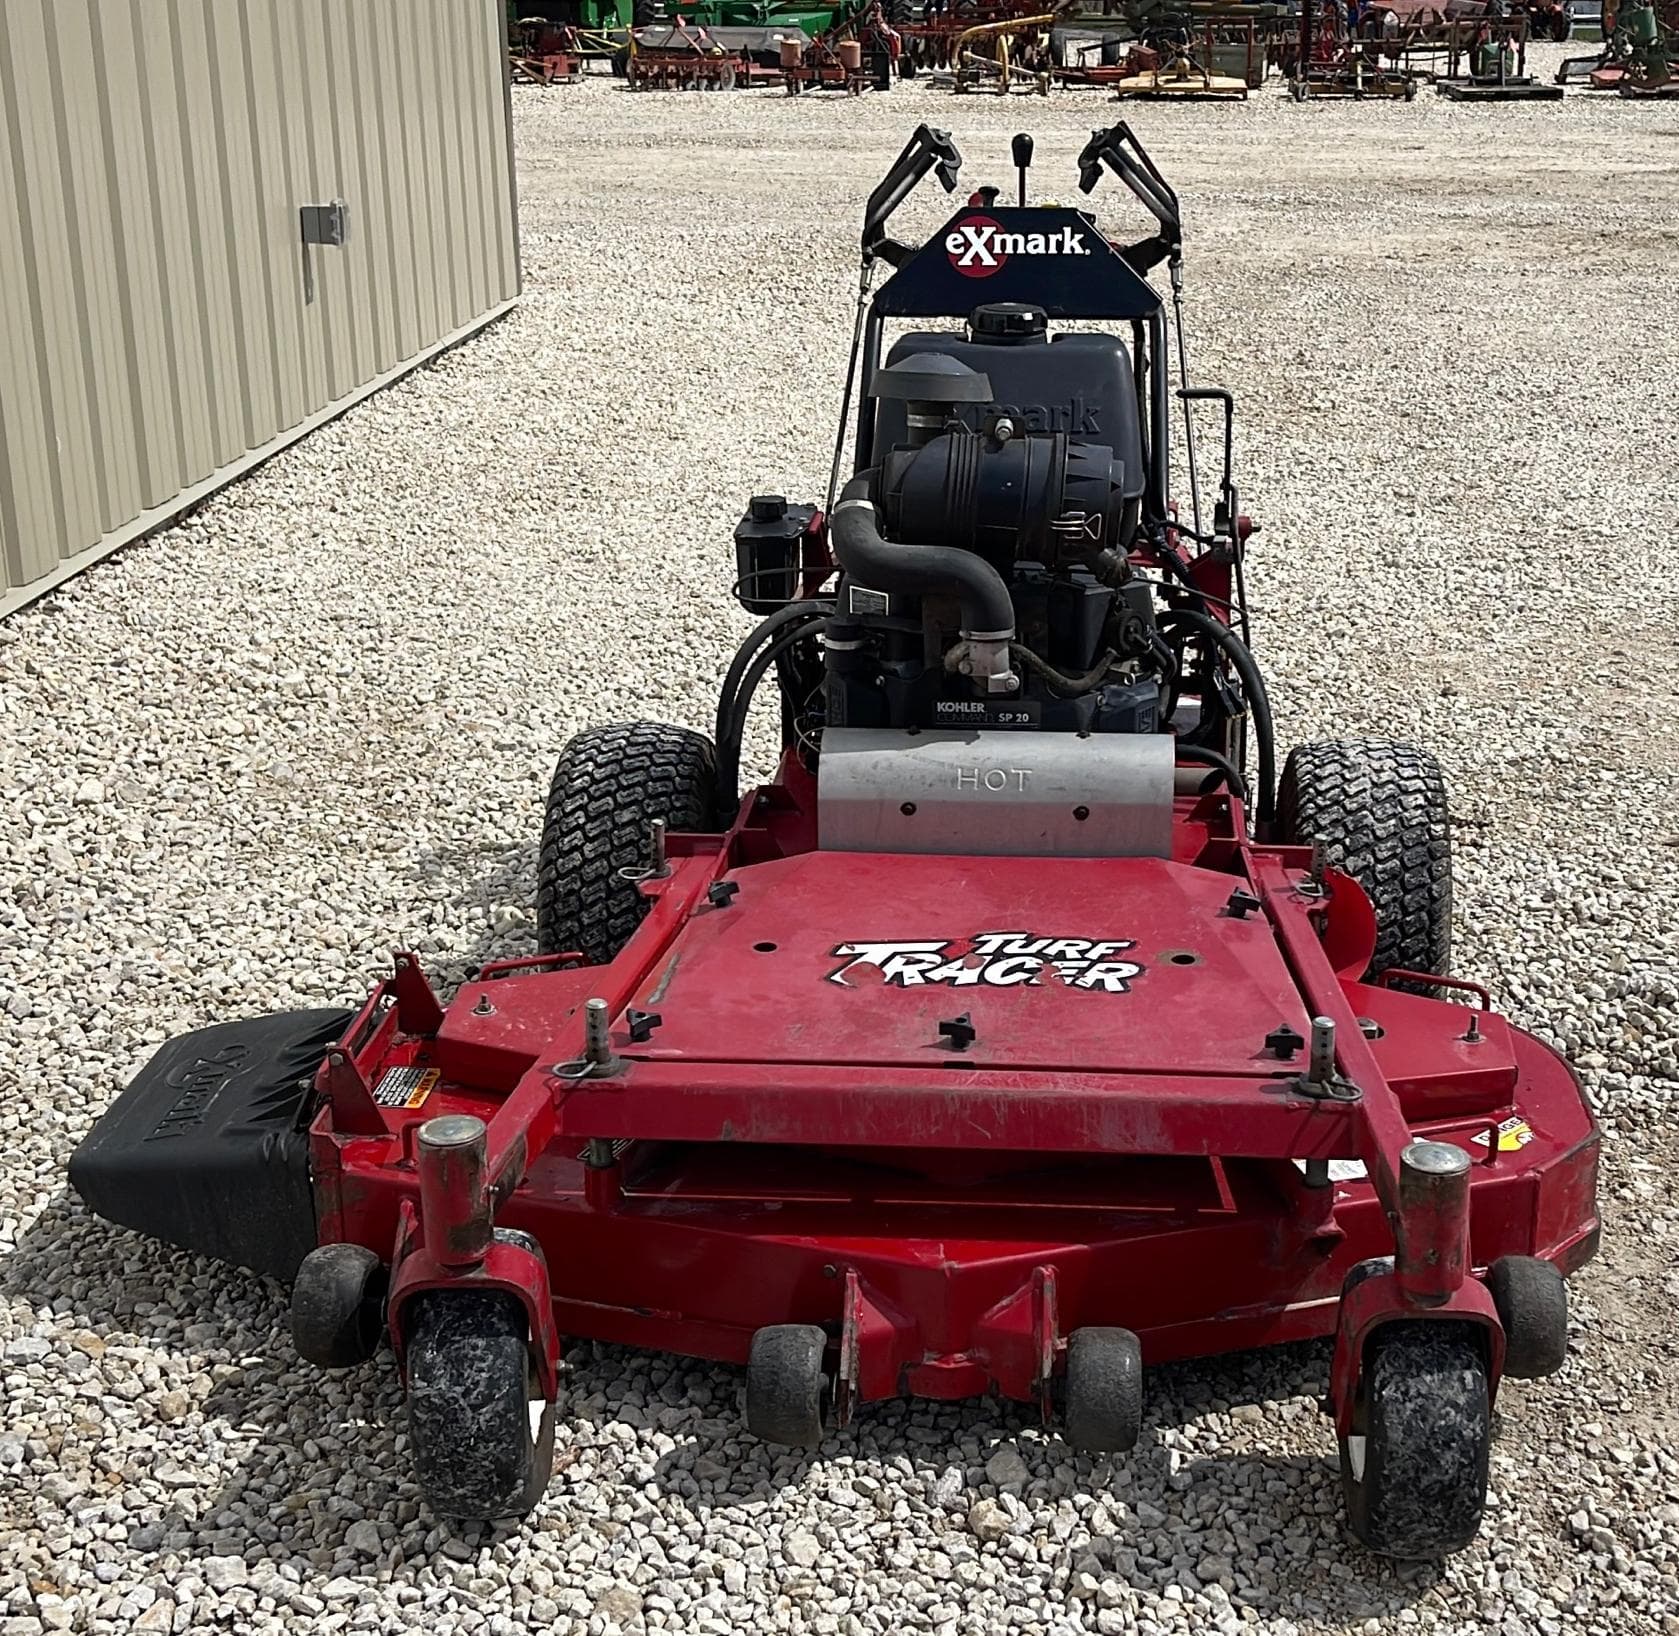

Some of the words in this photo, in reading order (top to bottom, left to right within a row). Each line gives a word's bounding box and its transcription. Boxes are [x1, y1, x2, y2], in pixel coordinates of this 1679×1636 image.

[937, 703, 985, 713] KOHLER
[998, 713, 1014, 722] SP
[1015, 713, 1030, 722] 20
[956, 768, 1033, 792] HOT
[973, 932, 1135, 960] TURF
[828, 941, 1144, 993] TRACER
